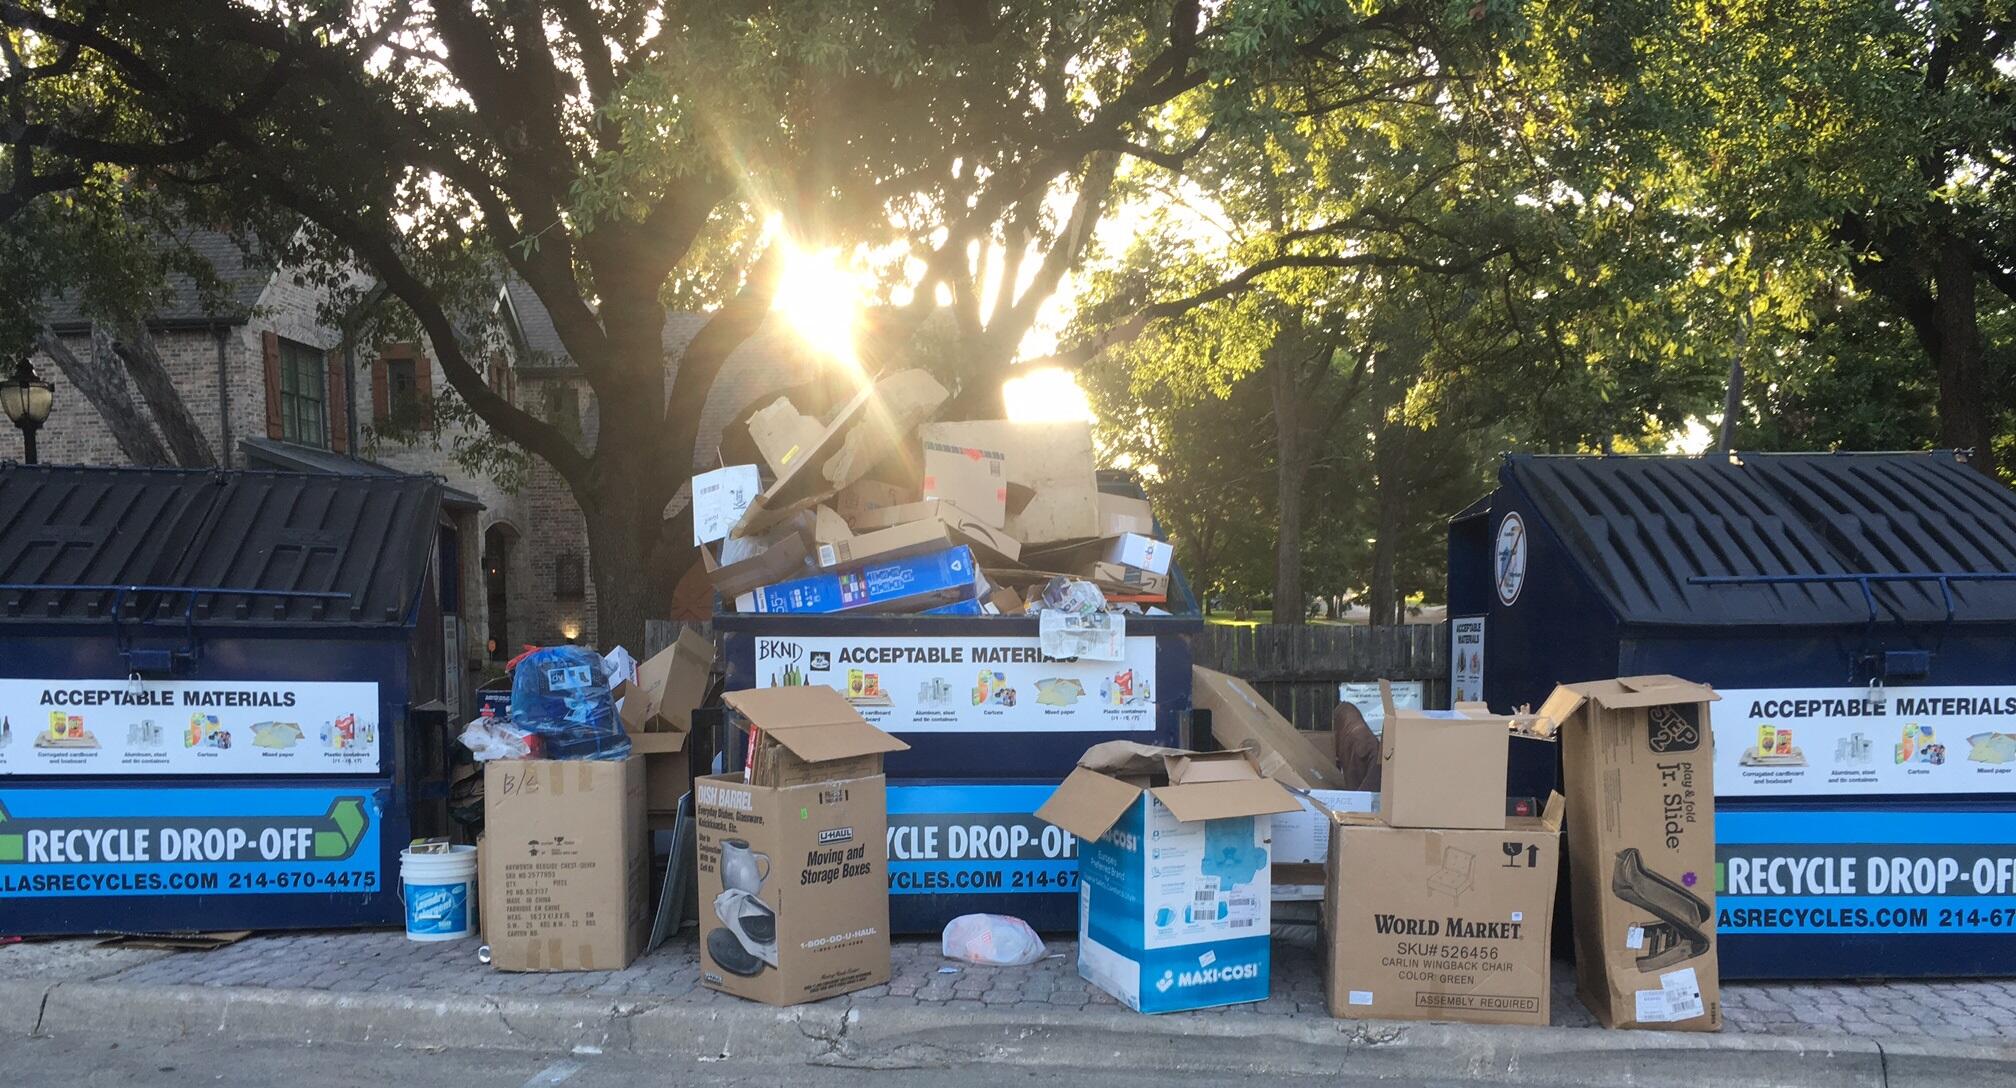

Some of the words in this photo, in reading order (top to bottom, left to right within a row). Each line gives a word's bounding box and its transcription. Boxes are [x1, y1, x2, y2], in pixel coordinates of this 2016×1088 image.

[838, 647, 963, 664] ACCEPTABLE
[40, 689, 175, 706] ACCEPTABLE
[183, 691, 296, 707] MATERIALS
[1748, 698, 1887, 718] ACCEPTABLE
[1896, 697, 2016, 716] MATERIALS
[1680, 762, 1693, 788] play
[1907, 768, 1930, 776] Cartons
[698, 784, 718, 806] DISH
[719, 788, 753, 811] BARREL
[1663, 794, 1684, 848] Slide
[27, 829, 150, 862] RECYCLE
[160, 827, 313, 861] DROP-OFF
[948, 825, 1079, 859] DROP-OF
[807, 847, 844, 867] Moving
[846, 843, 865, 861] and
[229, 872, 376, 890] 214-670-4475
[800, 867, 840, 886] Storage
[842, 862, 871, 878] Boxes
[1011, 871, 1079, 887] 214-67
[1728, 857, 1857, 895] RECYCLE
[1375, 914, 1439, 935] WORLD
[1446, 917, 1521, 939] MARKET
[1718, 908, 1928, 927] ASRECYCLES.COM
[1939, 908, 2016, 927] 214-67
[1397, 942, 1438, 956] SKU#
[1440, 945, 1498, 959] 526456
[1382, 957, 1419, 968] CARLIN
[1423, 960, 1479, 971] WINGBACK
[1481, 962, 1513, 972] CHAIR
[1439, 974, 1475, 984] GREEN
[1420, 995, 1475, 1006] ASSEMBLY
[1480, 998, 1534, 1009] REQUIRED
